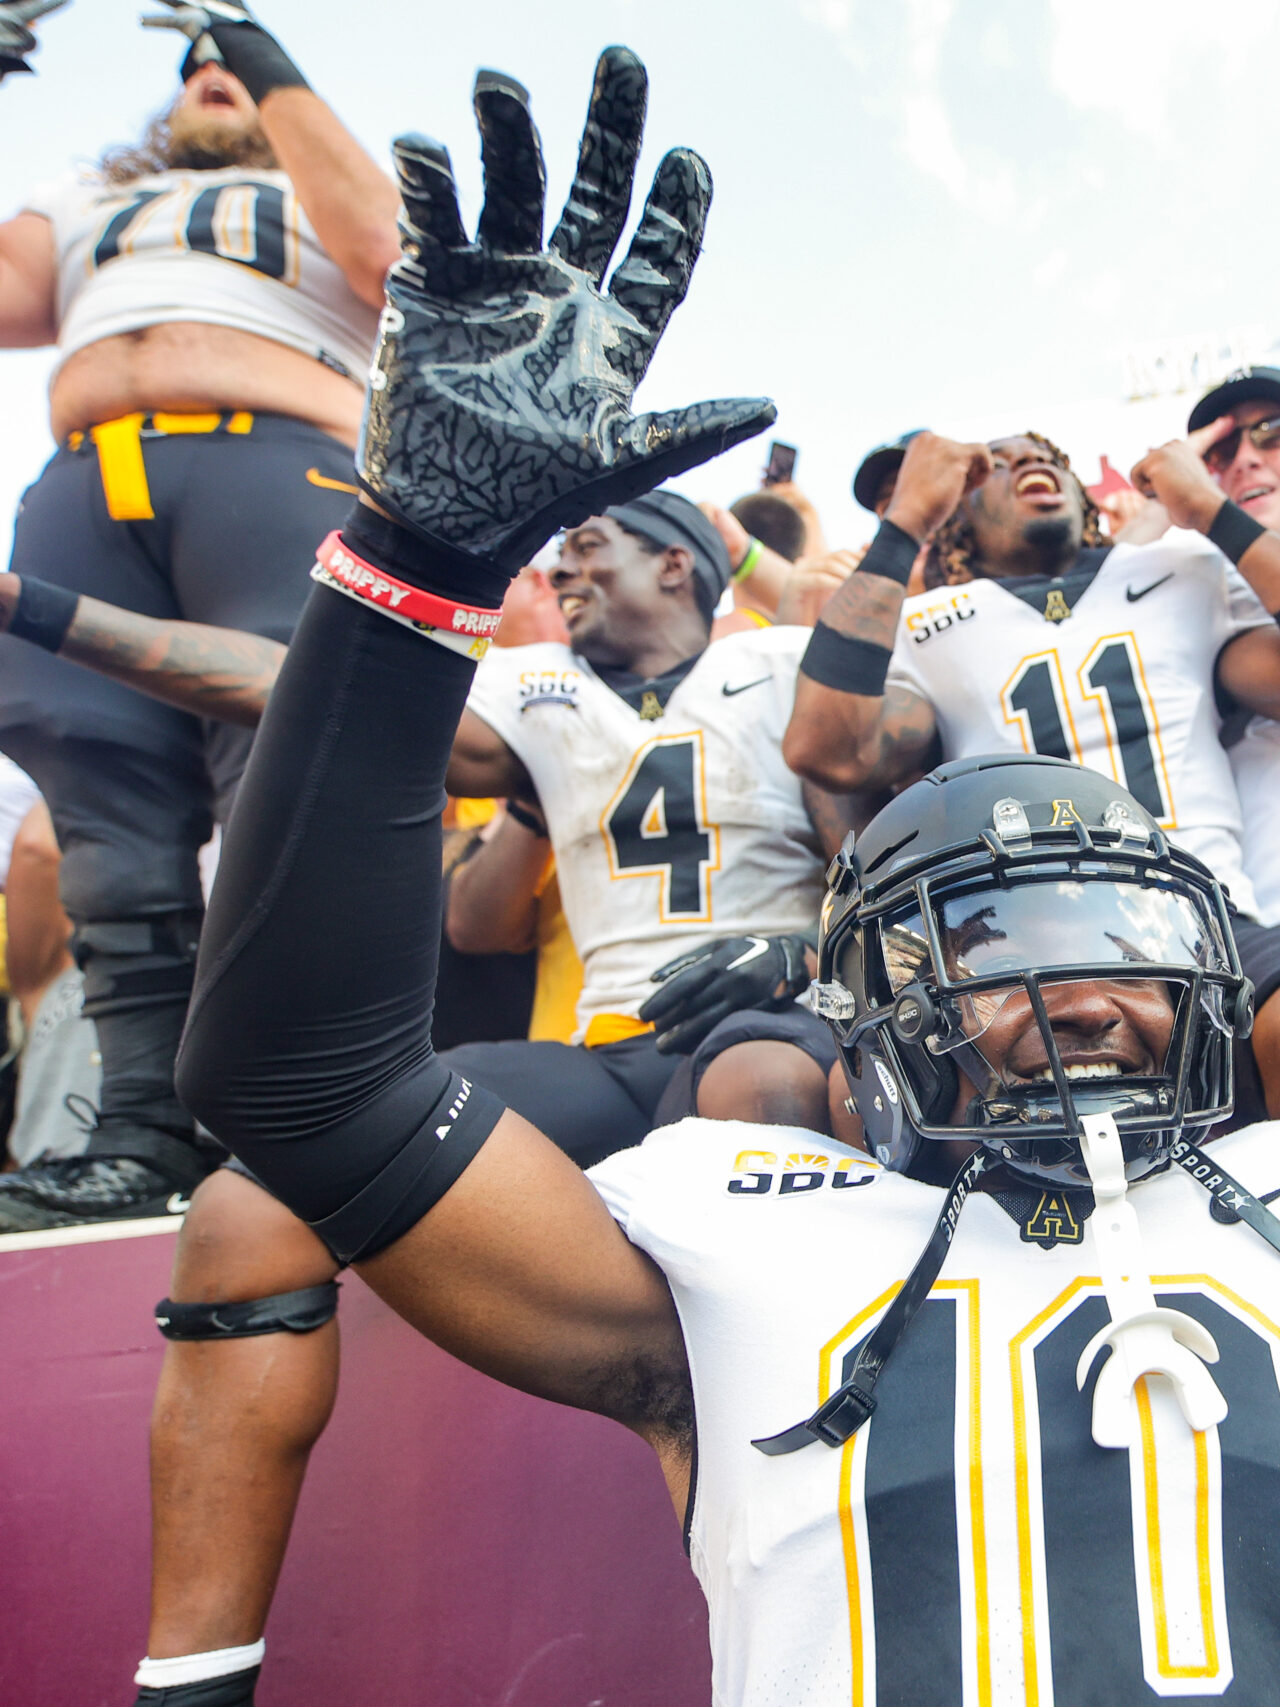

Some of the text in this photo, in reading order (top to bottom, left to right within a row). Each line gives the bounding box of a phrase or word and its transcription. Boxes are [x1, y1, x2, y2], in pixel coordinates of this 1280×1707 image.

[86, 178, 299, 288] 70
[329, 549, 410, 607] DRIPPY
[906, 594, 976, 643] SBC
[1000, 631, 1178, 829] 11
[598, 729, 720, 924] 4
[1050, 799, 1083, 826] A
[728, 1149, 882, 1195] SBC
[1170, 1141, 1237, 1201] SPORT
[940, 1169, 976, 1243] SPORT
